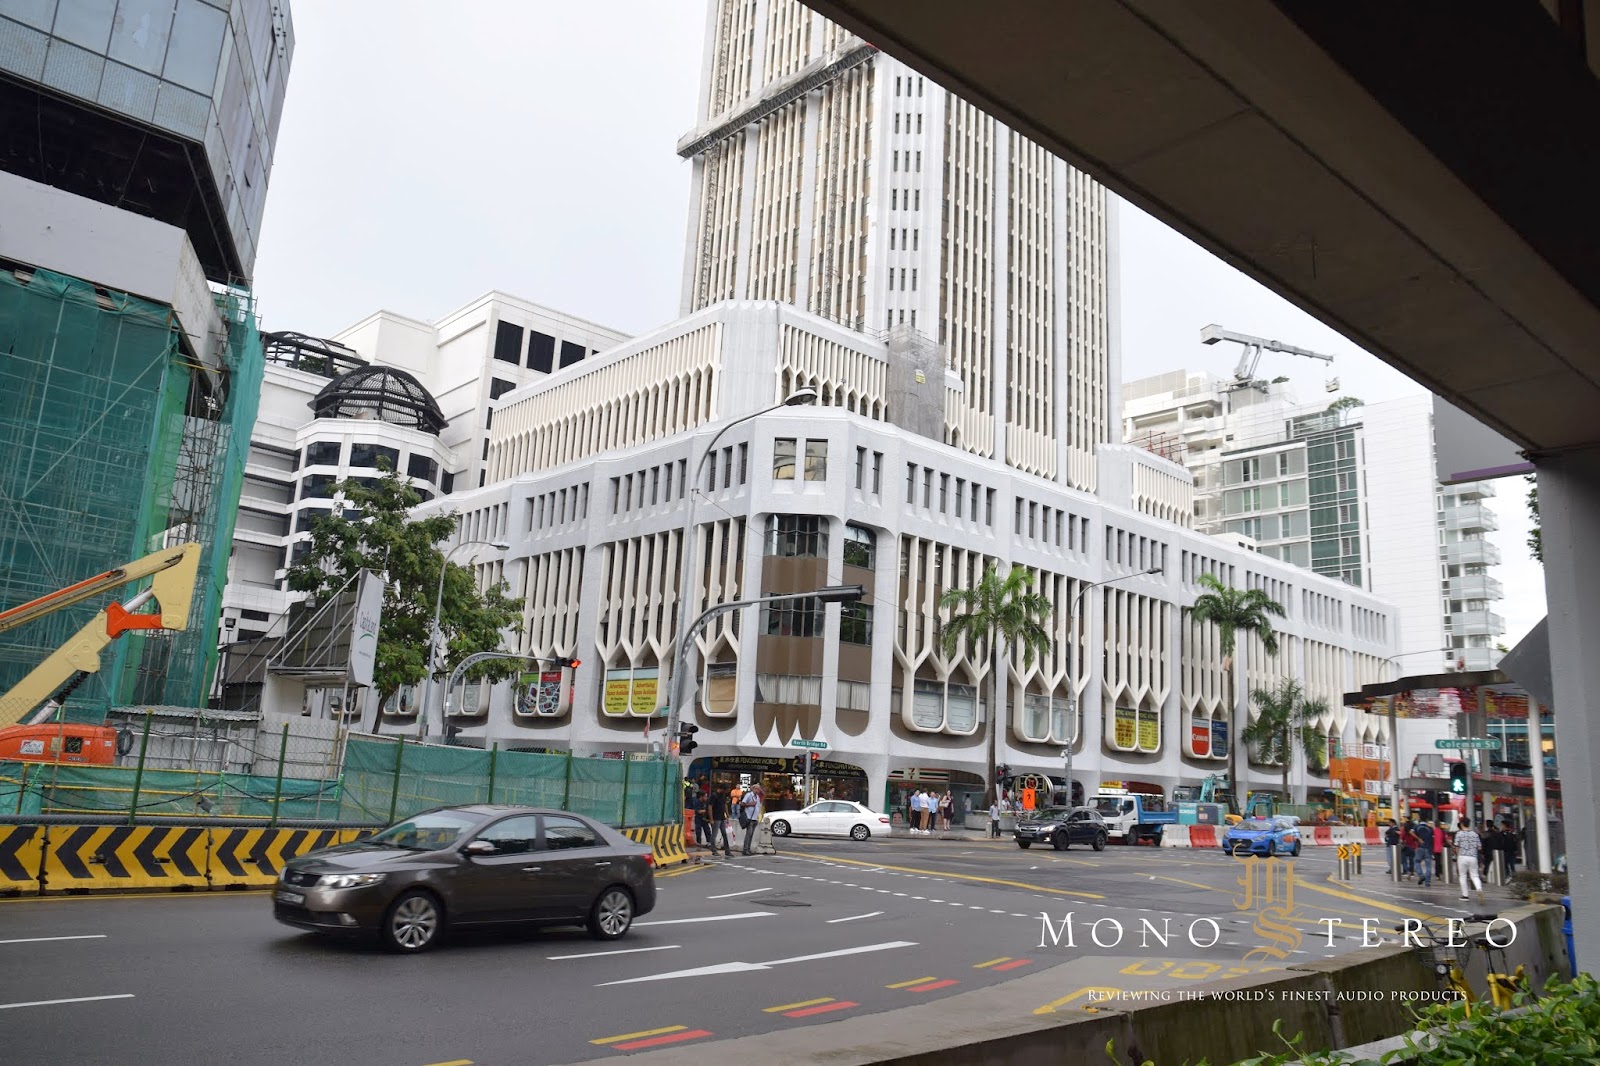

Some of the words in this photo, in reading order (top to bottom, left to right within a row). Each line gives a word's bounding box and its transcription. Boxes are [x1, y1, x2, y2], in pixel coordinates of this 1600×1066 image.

[1192, 733, 1209, 742] Canon
[1439, 740, 1482, 748] Coleman
[1484, 740, 1496, 748] St
